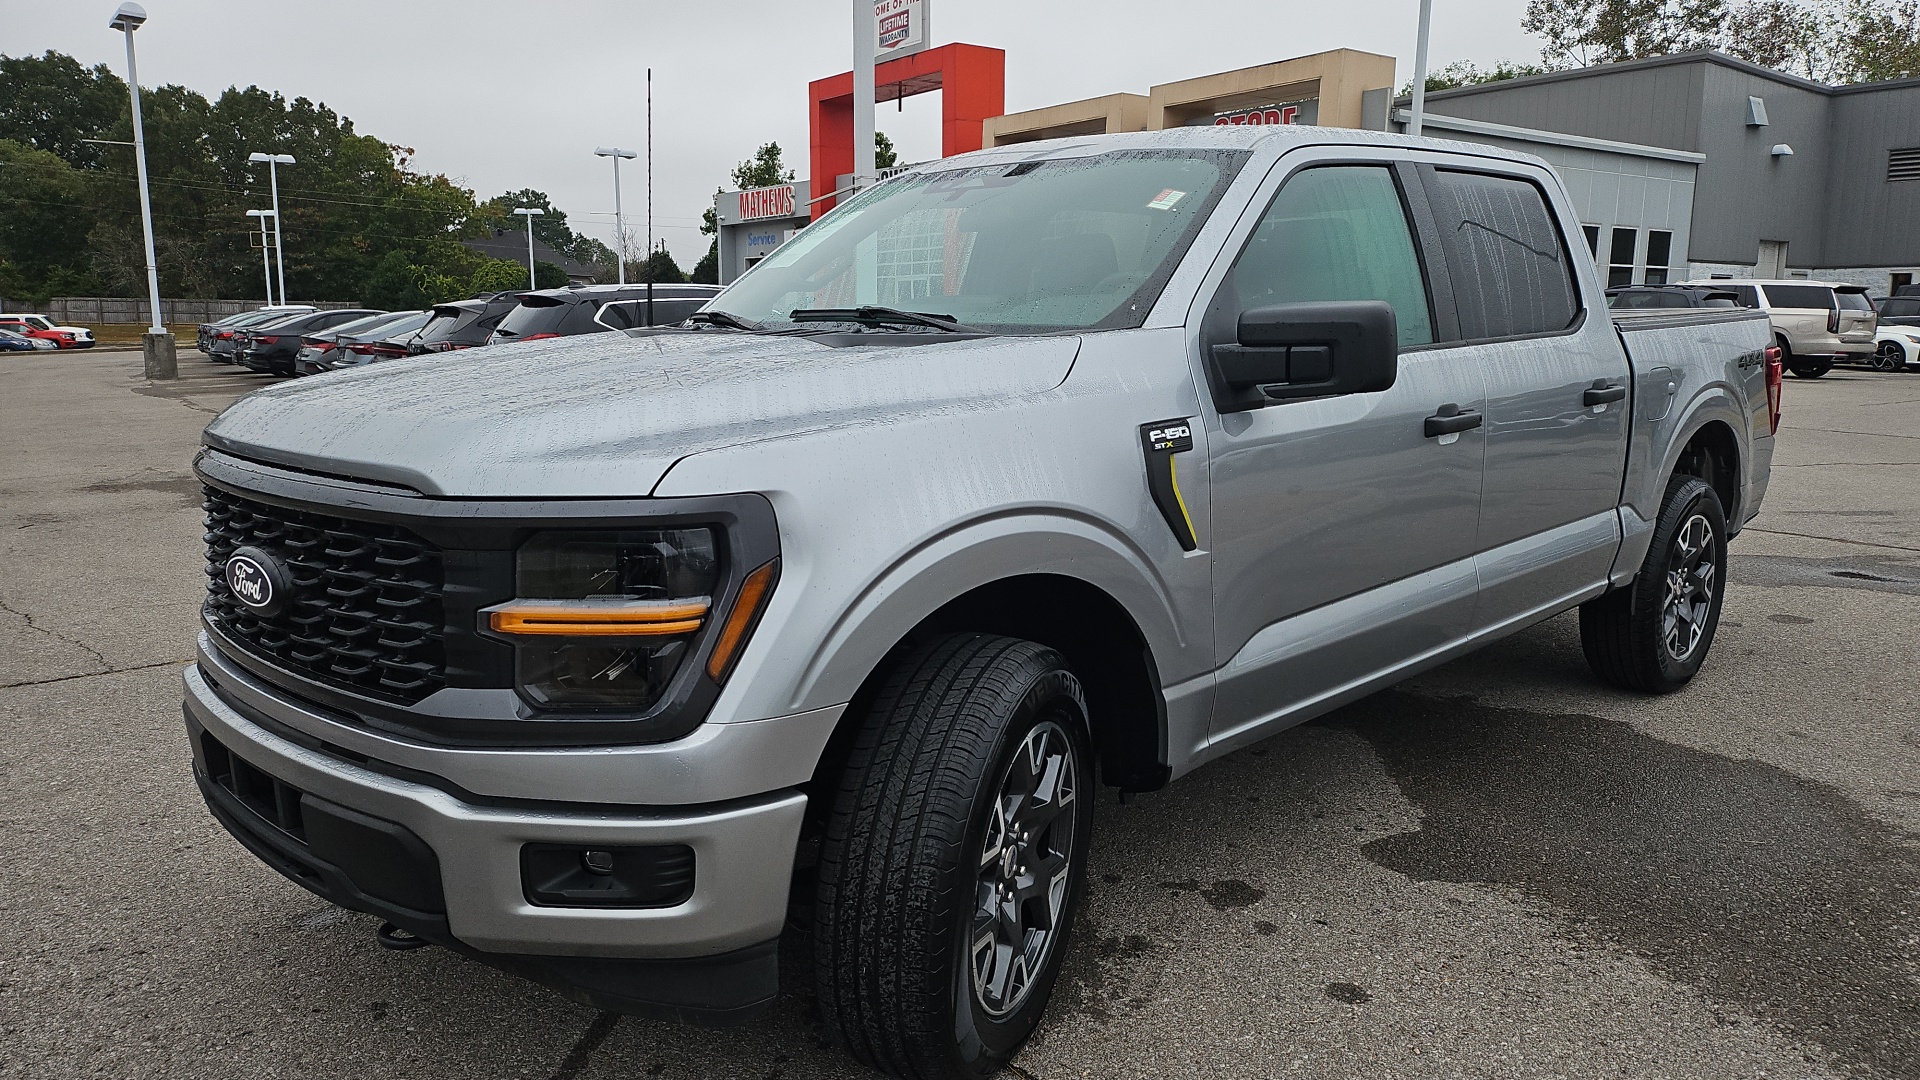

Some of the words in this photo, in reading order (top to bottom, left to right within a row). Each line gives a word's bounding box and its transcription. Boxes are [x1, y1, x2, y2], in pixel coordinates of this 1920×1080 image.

[874, 2, 890, 17] OME
[880, 13, 908, 33] LIFETIME
[880, 28, 909, 45] WARRANTY
[739, 186, 794, 220] MATHEWS
[748, 232, 776, 246] Service
[1149, 426, 1190, 442] F-150
[1154, 441, 1174, 450] STX
[234, 562, 262, 600] Ford
